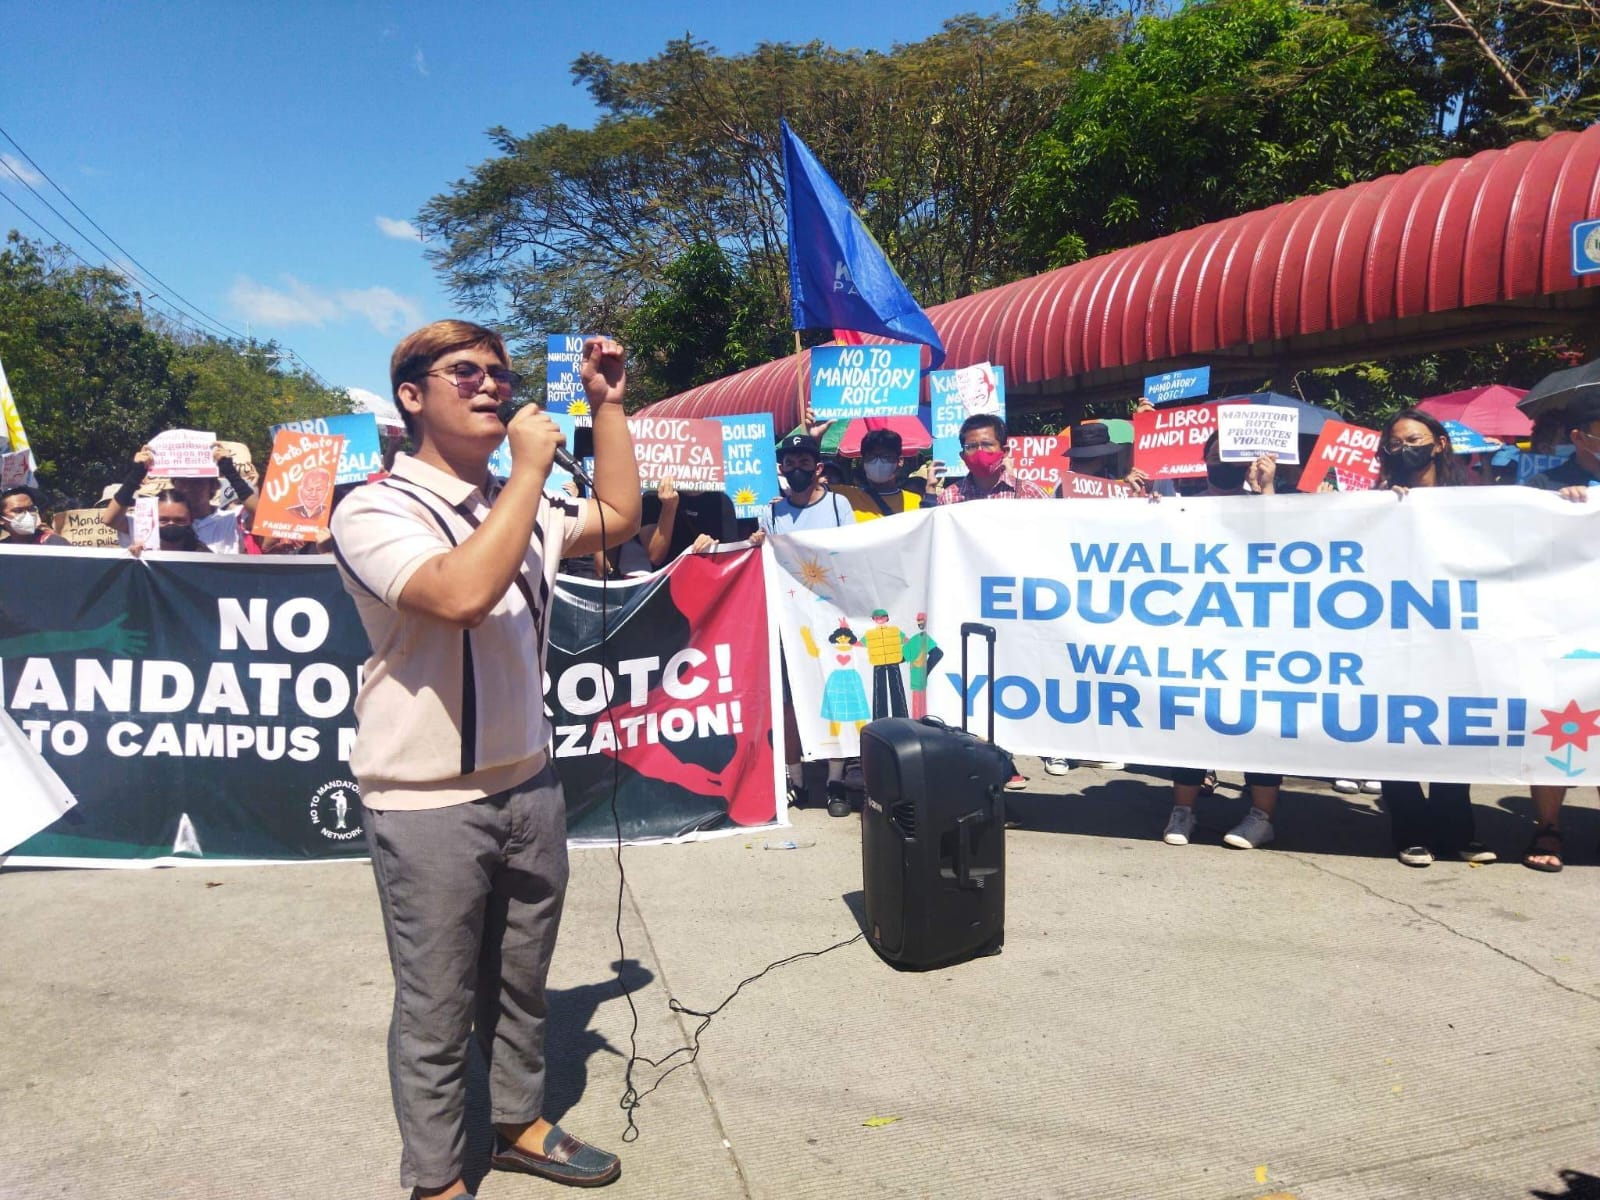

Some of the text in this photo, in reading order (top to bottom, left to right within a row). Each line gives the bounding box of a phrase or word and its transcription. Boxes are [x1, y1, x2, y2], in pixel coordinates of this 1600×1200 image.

[566, 336, 583, 352] NO
[547, 353, 583, 362] MANDATO
[838, 348, 891, 368] NO TO
[561, 372, 573, 382] NO
[815, 367, 915, 389] MANDATORY
[1148, 377, 1197, 394] MANDATORY
[547, 382, 584, 392] MANDATO
[840, 386, 889, 405] ROTC!
[1157, 388, 1184, 402] ROTC!
[814, 404, 916, 418] KABATAAN PARTYLIST
[1155, 407, 1216, 430] LIBRO.
[1222, 410, 1297, 422] MANDATORY
[722, 423, 766, 441] BOLISH
[1245, 419, 1277, 429] ROTC
[1138, 429, 1185, 450] HINDI
[1228, 428, 1292, 440] PROMOTES
[1233, 436, 1288, 448] VIOLENCE
[634, 443, 715, 465] BIGAT SA
[728, 443, 753, 460] NTF
[1008, 437, 1058, 458] P-PNP
[1020, 457, 1035, 466] OF
[1321, 443, 1381, 475] NTF-E
[638, 463, 721, 481] STUDYANTE
[1071, 477, 1104, 496] 100%
[1070, 541, 1365, 574] WALK FOR
[980, 576, 1478, 630] EDUCATION!
[218, 597, 330, 654] NO
[1065, 642, 1364, 686] WALK FOR
[0, 643, 733, 719] ANDATO OTC!
[946, 672, 1528, 748] YOUR FUTURE!
[22, 720, 89, 757] TO
[107, 721, 320, 762] CAMPUS
[549, 700, 743, 759] ZATION!
[310, 779, 361, 824] NO TO MANDATO
[320, 825, 364, 840] NETWORK
